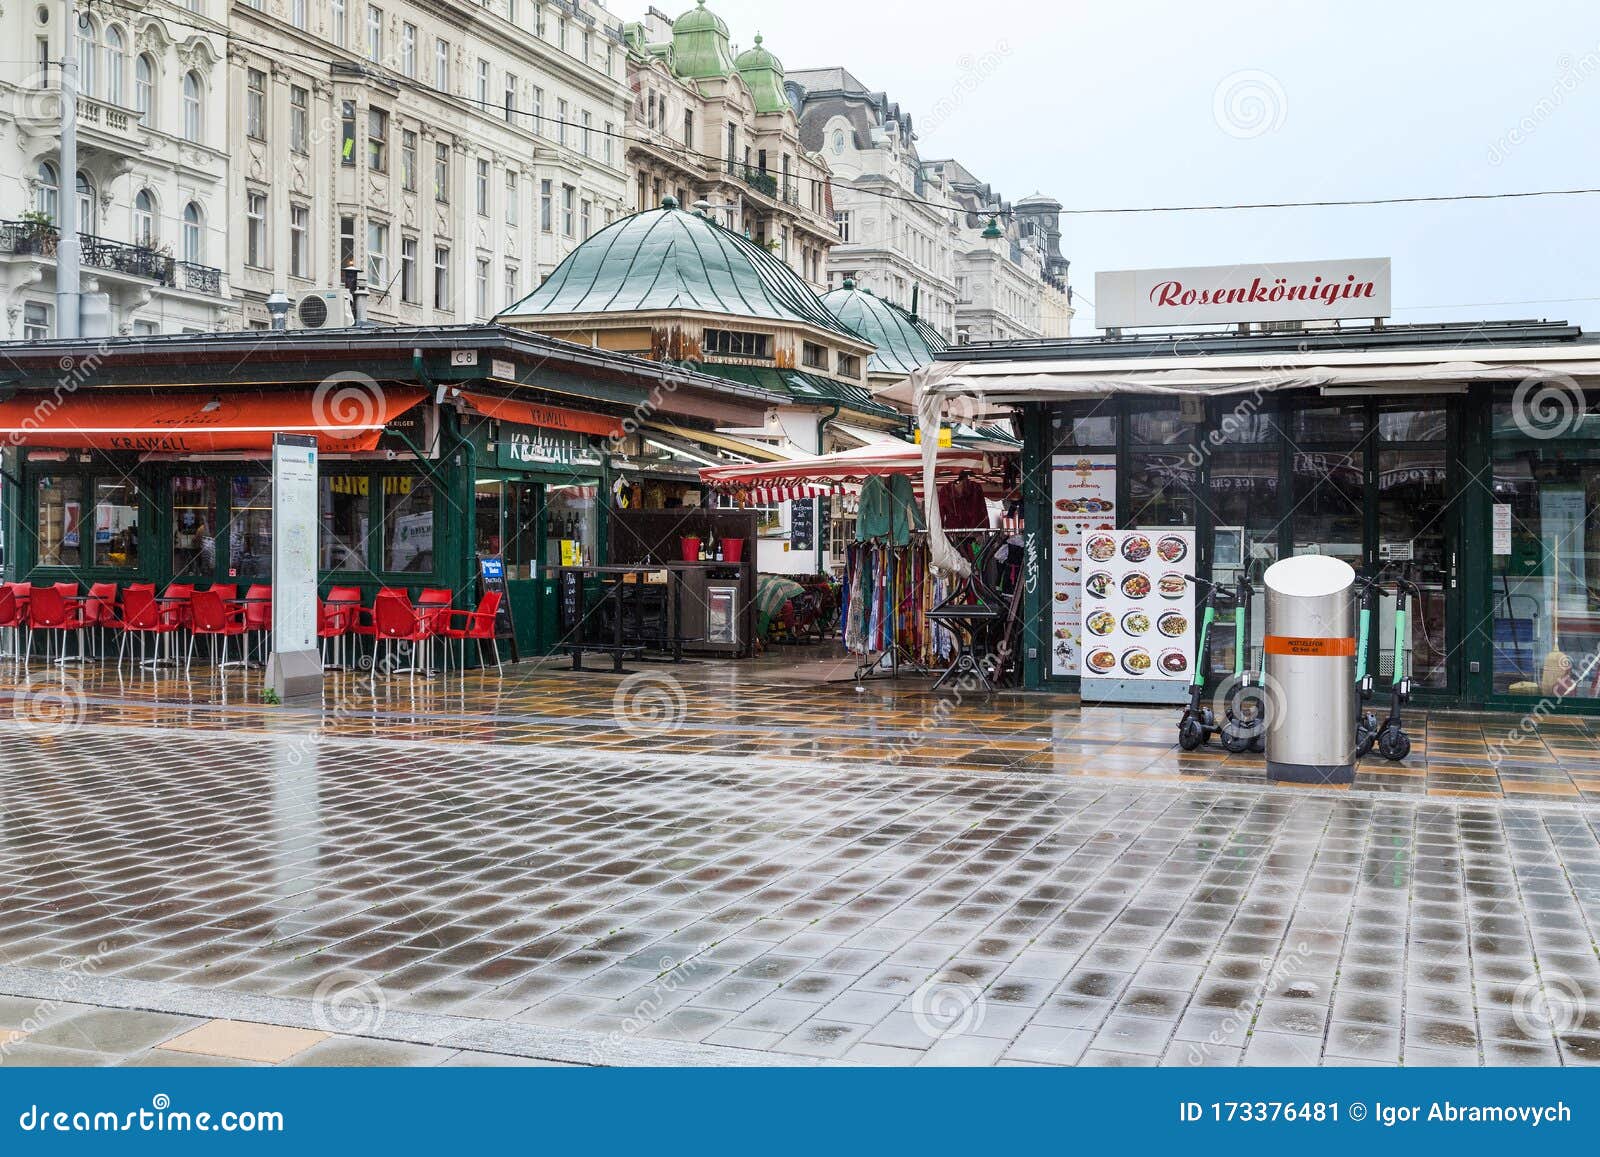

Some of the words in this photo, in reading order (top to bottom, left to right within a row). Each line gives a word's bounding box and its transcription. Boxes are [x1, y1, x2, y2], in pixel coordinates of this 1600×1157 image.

[1150, 275, 1376, 305] Rosenkönigin
[456, 353, 463, 363] C
[466, 353, 472, 363] 8
[530, 408, 568, 427] KRAWALL
[110, 437, 190, 451] KRAWALL
[510, 432, 576, 464] KRAWALL
